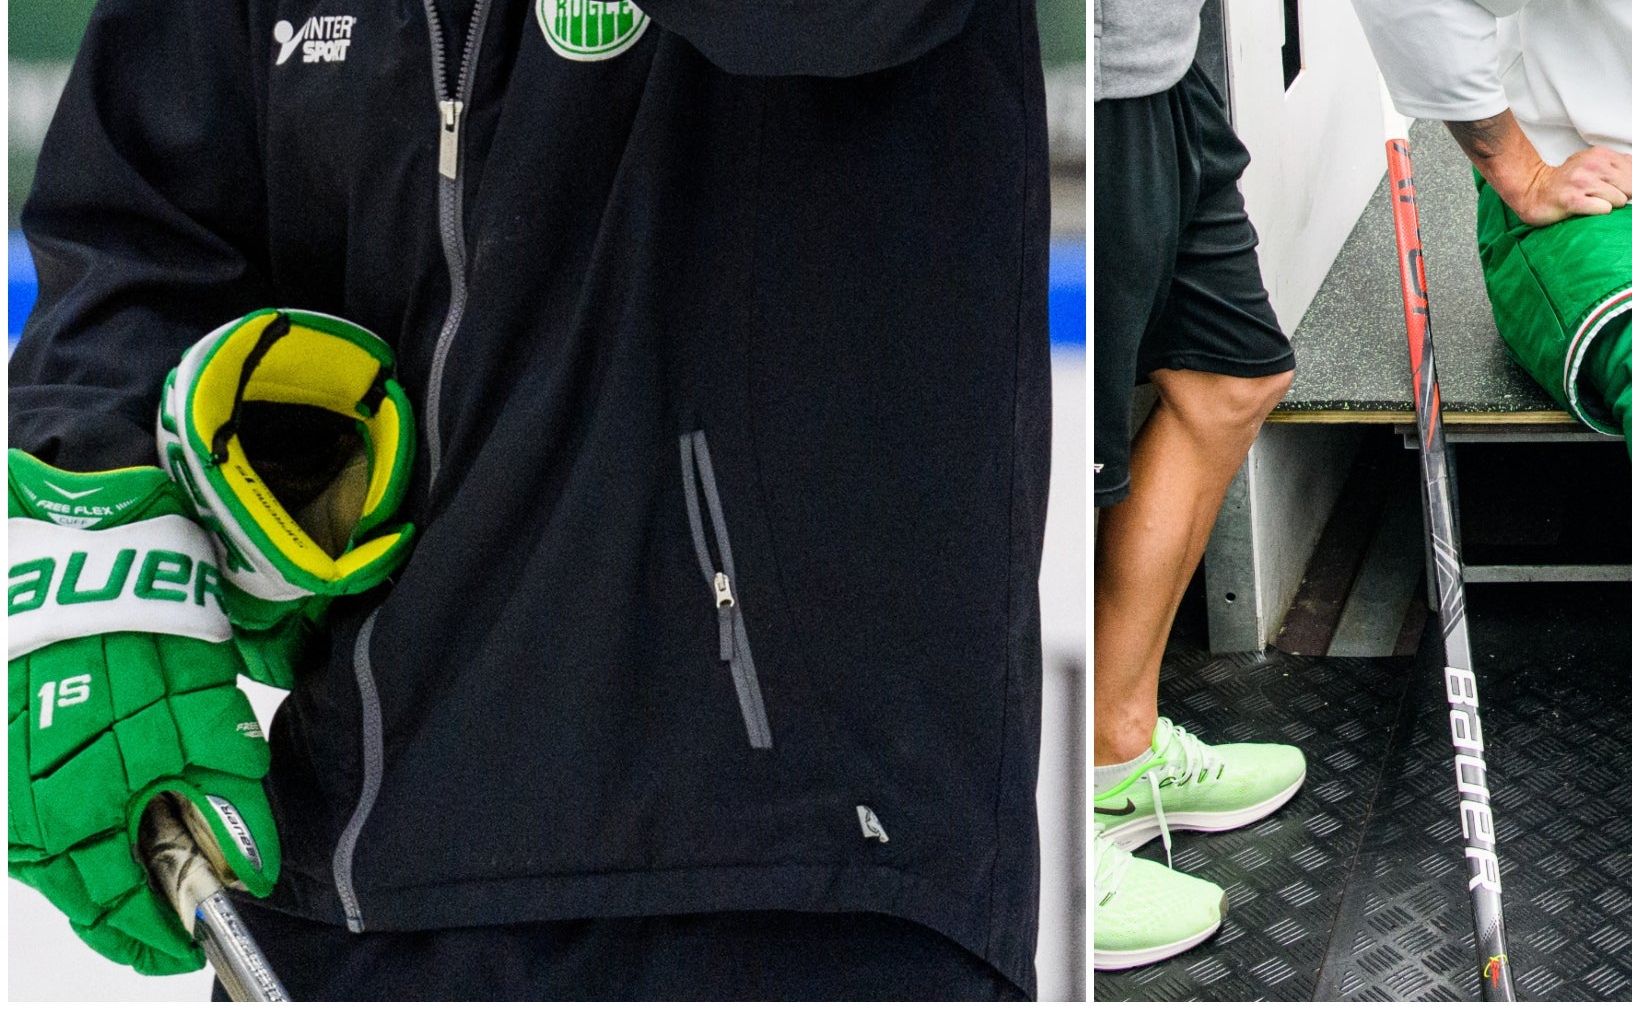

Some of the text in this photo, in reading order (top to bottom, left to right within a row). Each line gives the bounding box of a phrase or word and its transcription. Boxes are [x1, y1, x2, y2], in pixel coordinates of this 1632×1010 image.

[303, 16, 353, 40] INTER
[303, 40, 351, 63] SPORT
[36, 500, 114, 516] FREE FLEX
